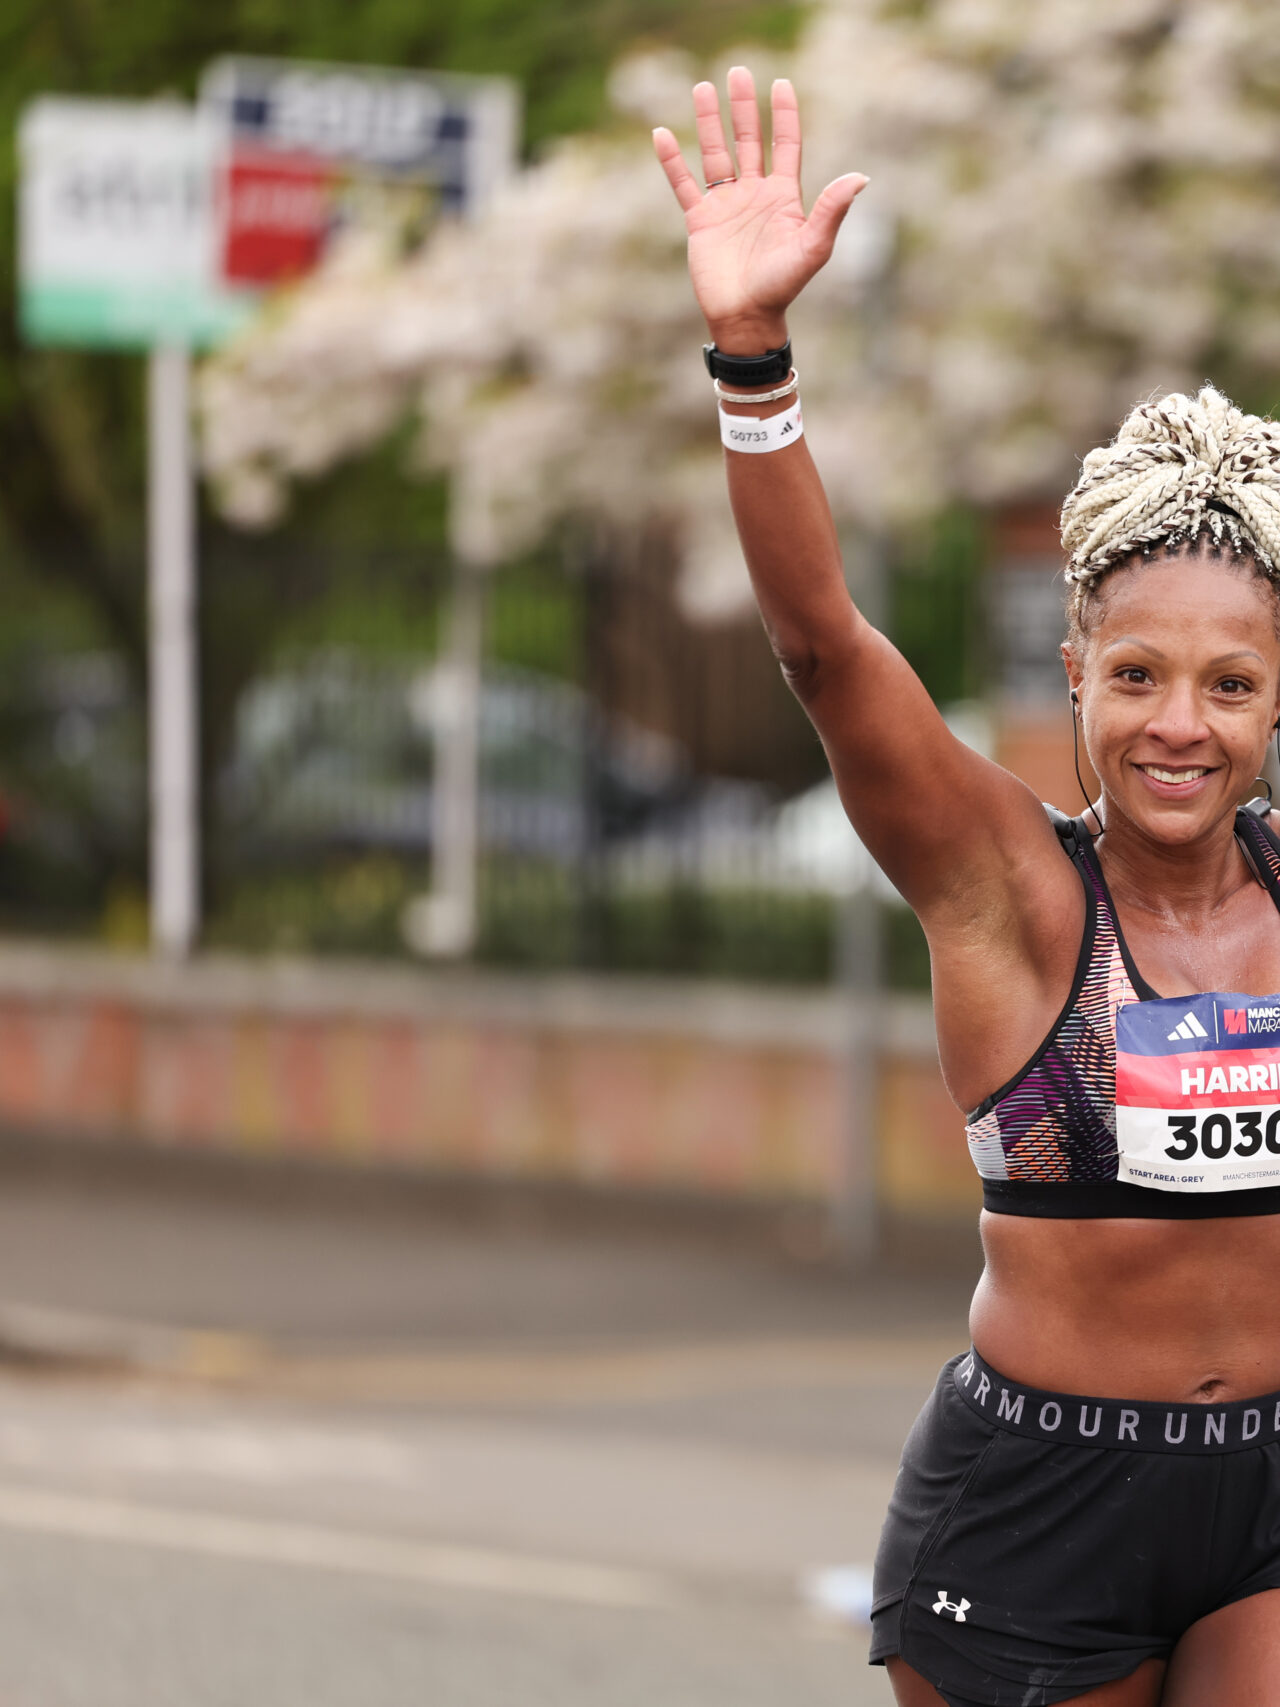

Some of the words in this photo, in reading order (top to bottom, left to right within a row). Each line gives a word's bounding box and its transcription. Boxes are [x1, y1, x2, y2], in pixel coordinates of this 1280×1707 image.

[1129, 1168, 1153, 1179] START
[1181, 1175, 1204, 1183] GREY
[961, 1354, 1139, 1442] ARMOUR
